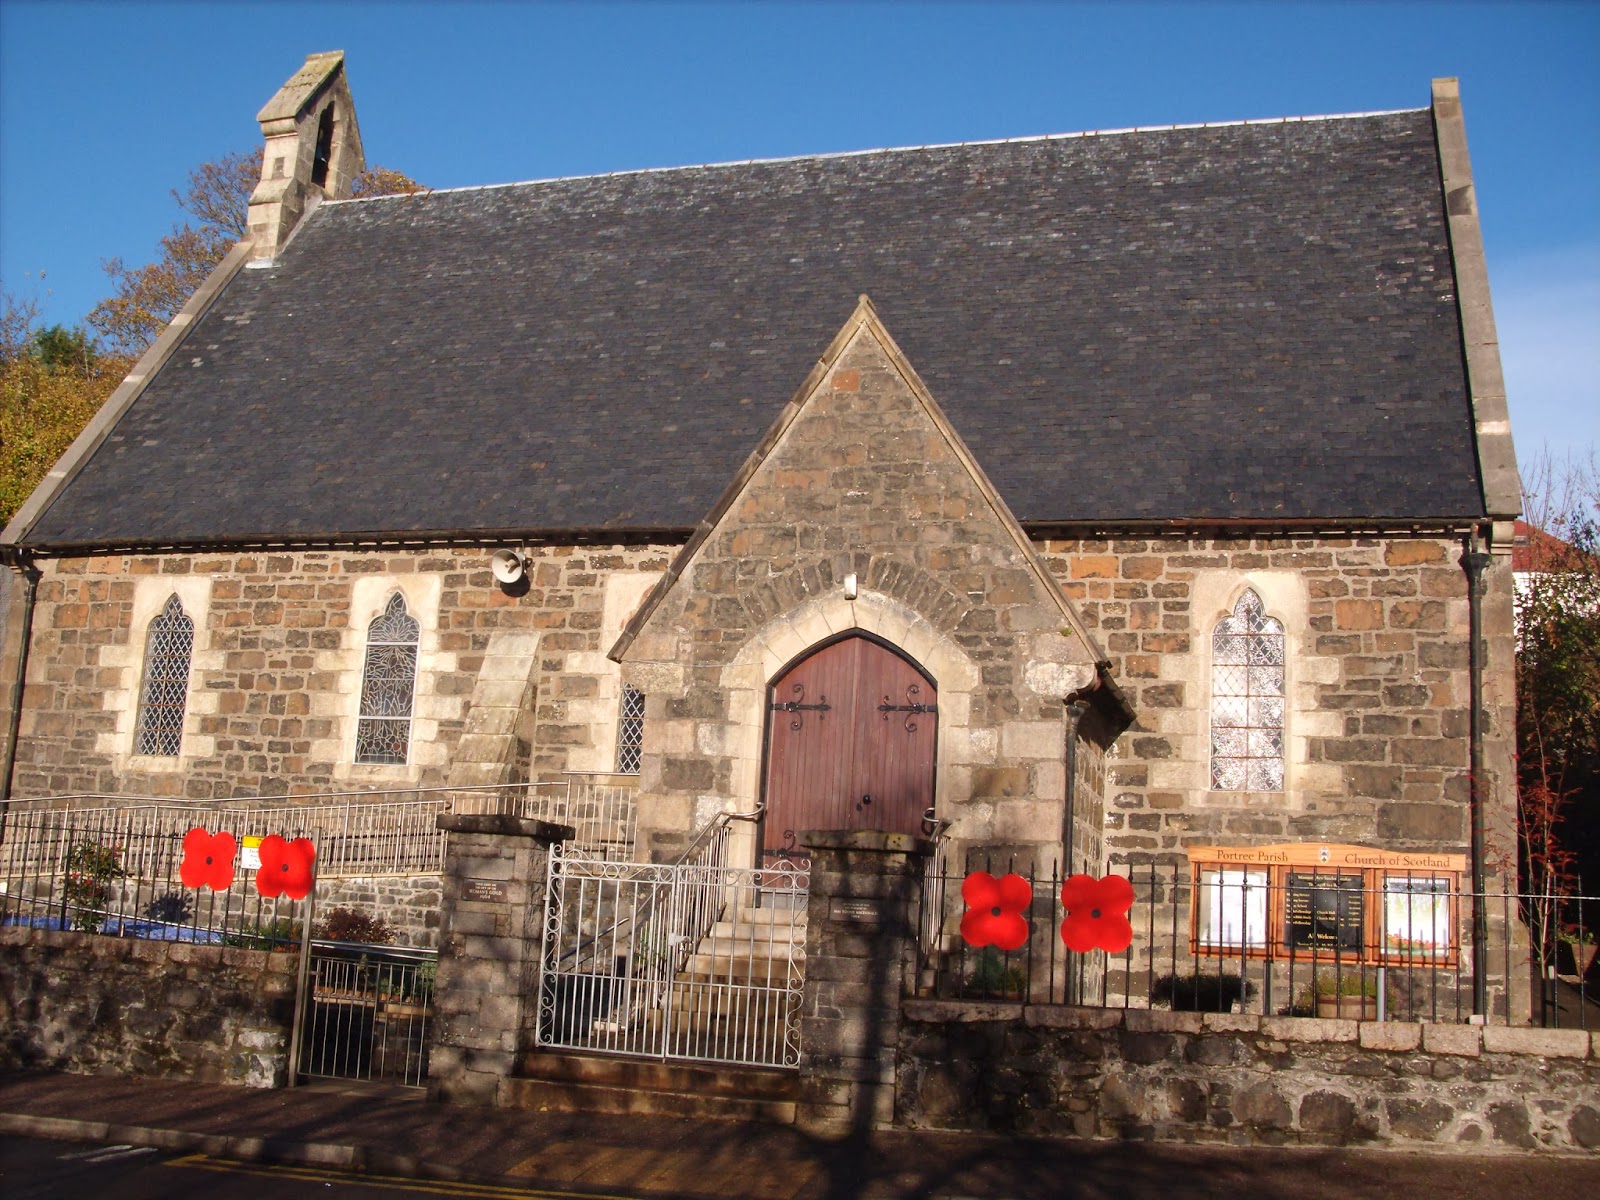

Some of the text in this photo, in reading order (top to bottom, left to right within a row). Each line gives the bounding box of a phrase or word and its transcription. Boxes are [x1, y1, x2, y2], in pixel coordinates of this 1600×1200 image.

[1217, 850, 1450, 867] Portree Parish Church of Scotland
